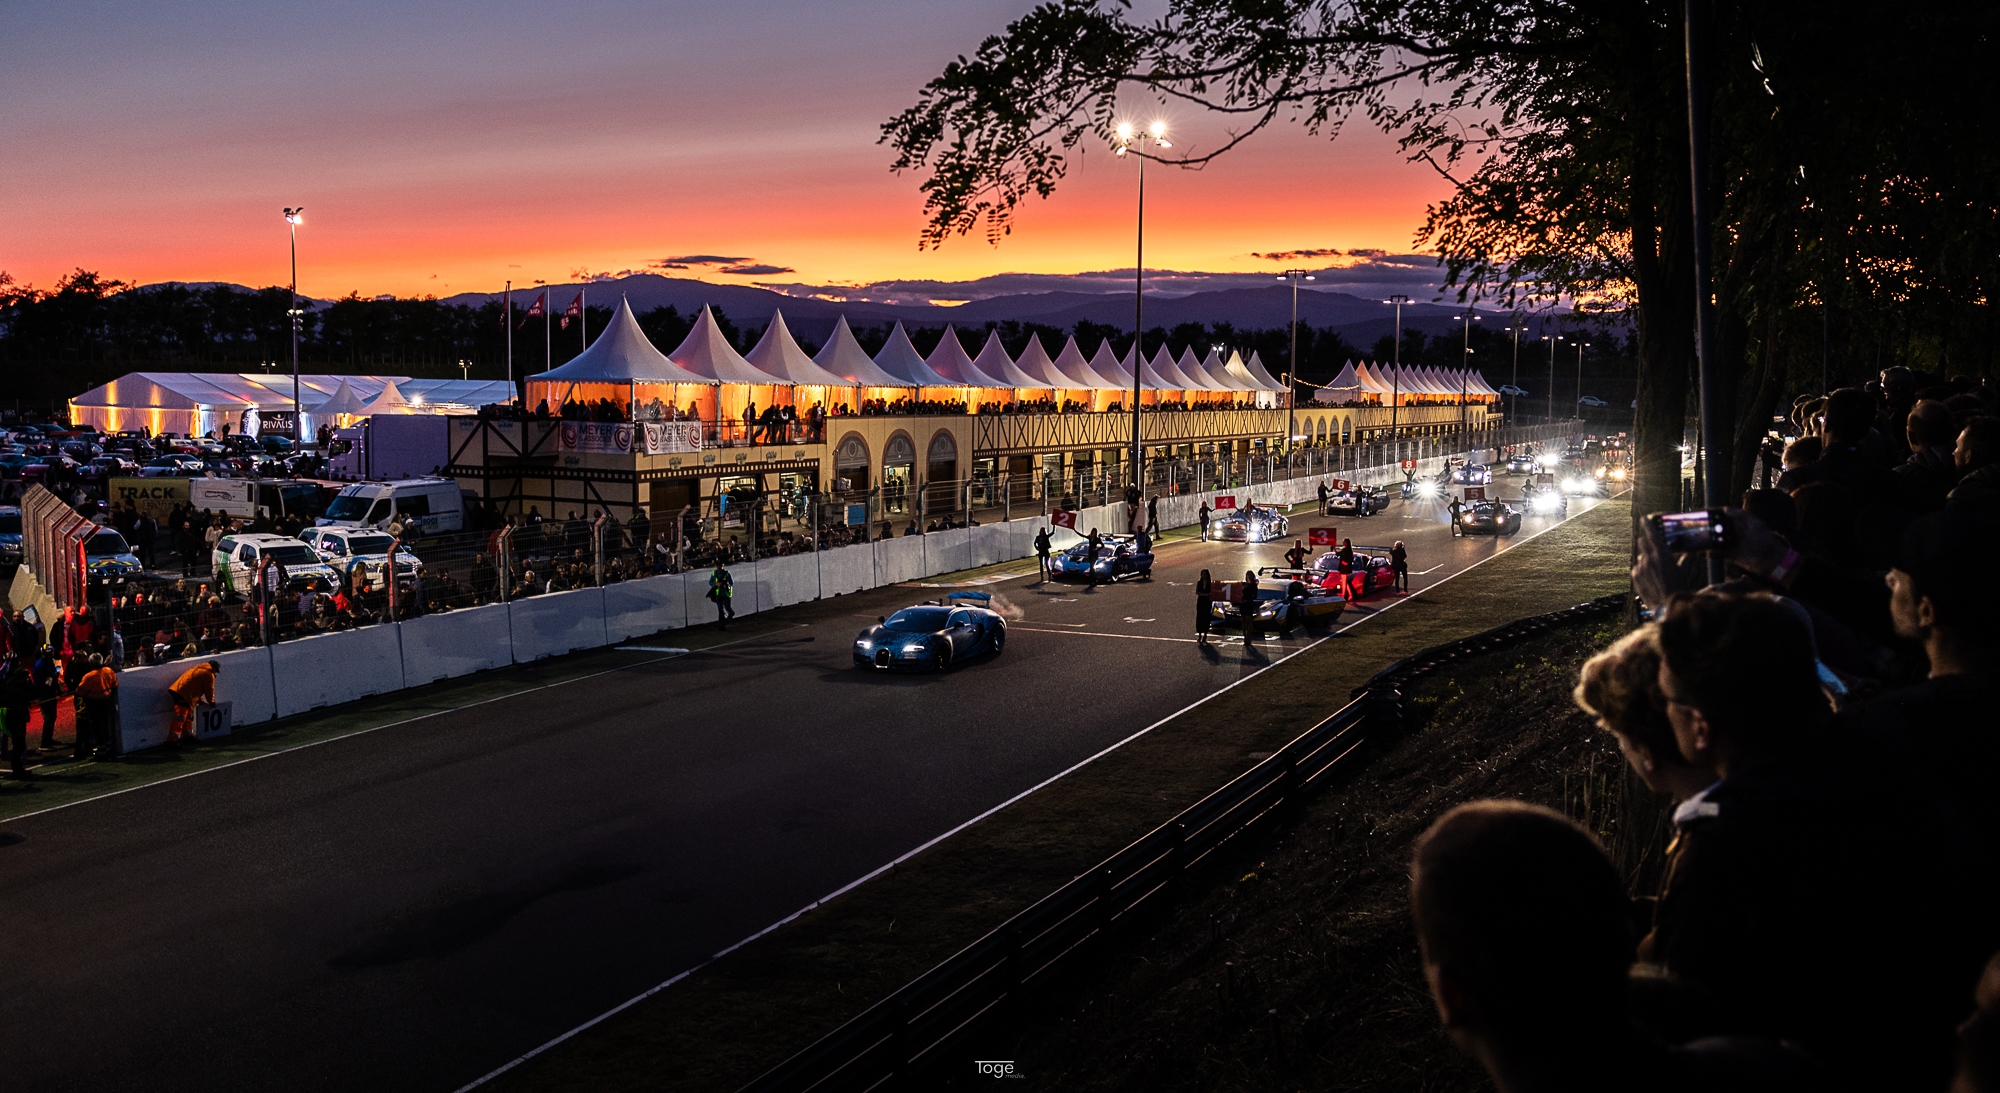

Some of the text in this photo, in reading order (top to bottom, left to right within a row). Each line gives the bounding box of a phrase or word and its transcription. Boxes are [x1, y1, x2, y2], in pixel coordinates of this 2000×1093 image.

[262, 420, 293, 429] RIVALIS
[579, 424, 613, 435] MEYER
[660, 424, 687, 435] MEYER
[1337, 480, 1344, 489] 6
[118, 487, 174, 498] TRACK
[1470, 489, 1479, 499] 5
[1220, 498, 1230, 508] 4
[1059, 512, 1069, 527] 2
[1316, 529, 1328, 545] 3
[1221, 583, 1232, 600] 1
